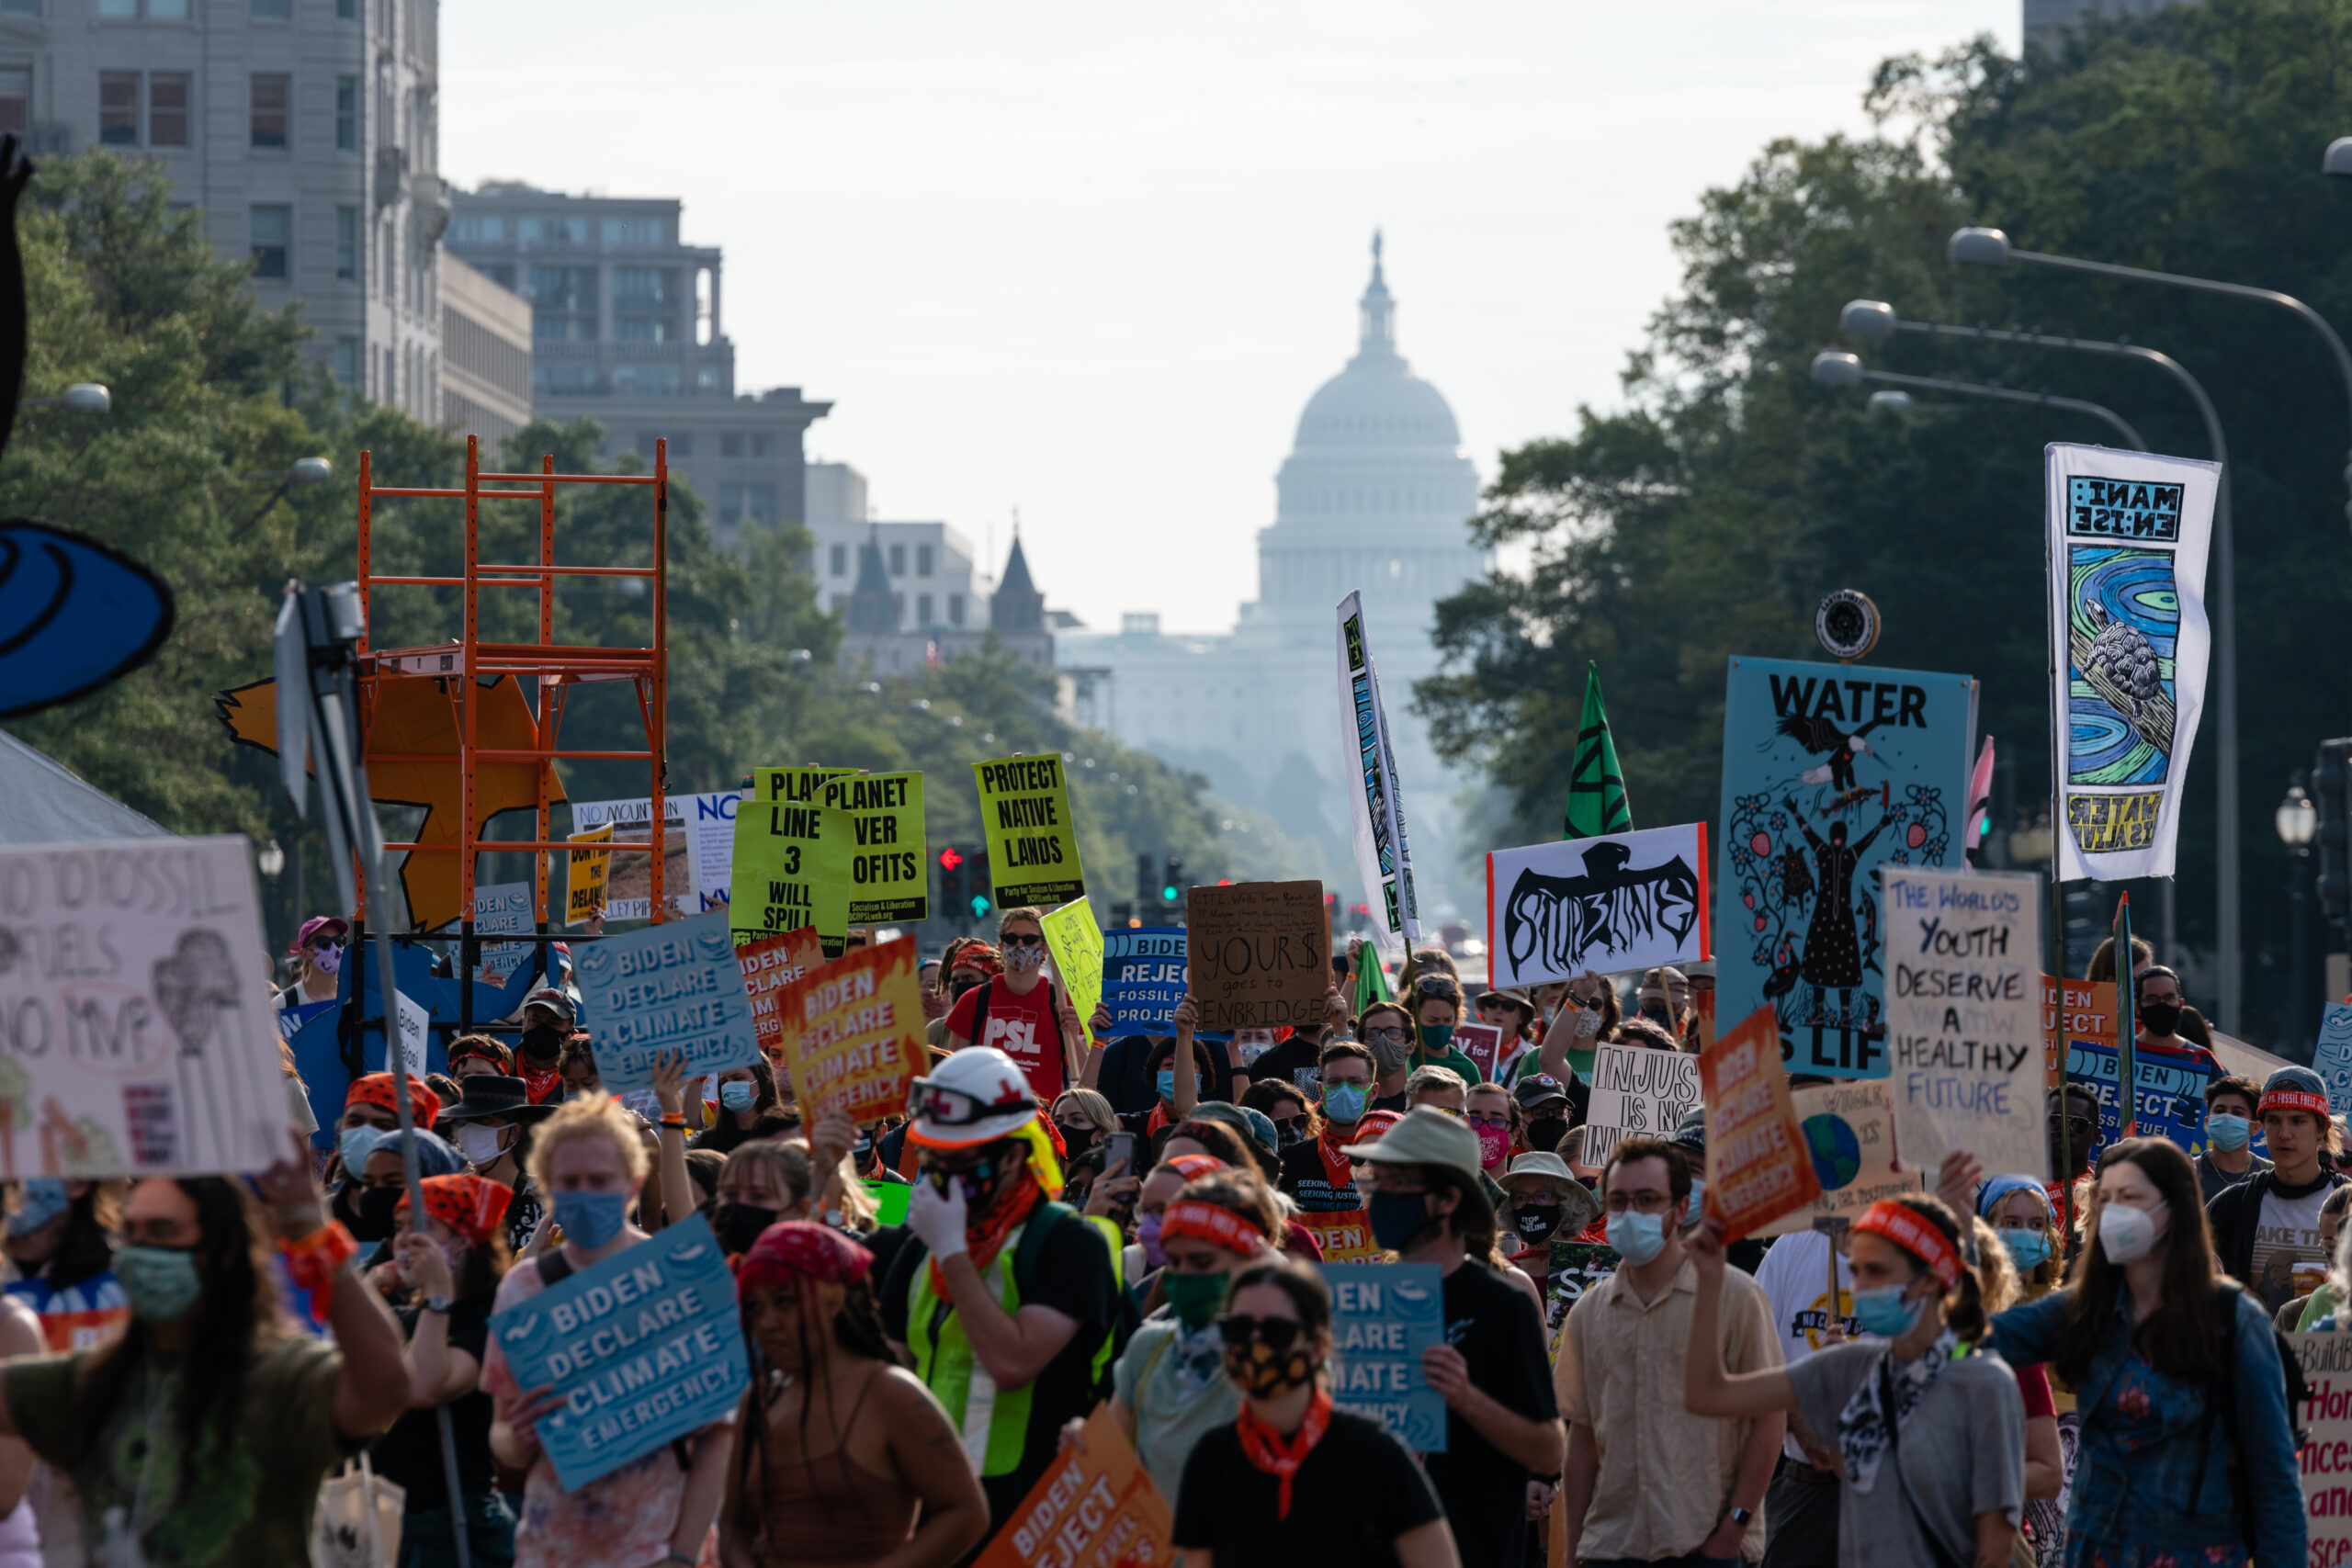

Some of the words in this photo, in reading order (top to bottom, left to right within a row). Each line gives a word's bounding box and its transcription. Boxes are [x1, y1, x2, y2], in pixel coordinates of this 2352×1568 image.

[1769, 674, 1927, 728] WATER
[771, 773, 845, 802] PLAN
[981, 760, 1057, 795] PROTECT
[696, 795, 742, 820] NO
[825, 778, 909, 810] PLANET
[580, 806, 602, 824] NO
[606, 801, 679, 821] MOUNIN
[770, 807, 821, 840] LINE
[997, 796, 1057, 829] NATIVE
[854, 815, 898, 846] VER
[785, 845, 802, 875] 3
[1004, 835, 1063, 868] LANDS
[591, 864, 602, 880] THE
[853, 852, 917, 884] OFITS
[474, 897, 505, 914] IDEN
[769, 881, 812, 908] WILL
[852, 901, 880, 912] Socialism
[880, 900, 886, 909] &
[886, 898, 916, 909] Liberation
[1004, 887, 1020, 897] Party
[1890, 879, 1929, 909] THE
[474, 916, 517, 933] CLARE
[1918, 917, 2010, 958] YOUTH
[616, 938, 695, 976] BIDEN
[739, 946, 789, 976] IDEN
[1136, 939, 1186, 956] BIDE
[1300, 932, 1319, 974] $
[607, 967, 718, 1011] DECLARE
[743, 965, 806, 996] CLARE
[1121, 964, 1188, 984] REJE
[1223, 978, 1257, 999] goes
[1268, 976, 1283, 989] to
[1895, 963, 2025, 1003] DESERVE
[803, 965, 876, 1021] BIDEN
[1118, 989, 1170, 1002] FOSSIL
[2043, 988, 2092, 1009] IDEN
[399, 1008, 420, 1040] Biden
[615, 998, 727, 1044] CLIMATE
[1117, 1009, 1175, 1022] PROJE
[1204, 998, 1325, 1026] ENBRIDGE
[1943, 1006, 1962, 1035] A
[2044, 1012, 2106, 1033] JECT
[798, 1000, 895, 1063] DECLARE
[984, 1018, 1042, 1055] PSL
[401, 1046, 419, 1069] elosi
[1472, 1044, 1490, 1057] for
[1811, 1027, 1886, 1071] LIF
[1896, 1033, 2030, 1073] HEALTHY
[803, 1035, 900, 1095] CLIMATE
[1595, 1046, 1700, 1104] INJUS
[1906, 1073, 2012, 1115] FUTURE
[2277, 1093, 2299, 1104] FOSSIL
[2300, 1094, 2316, 1107] FUELS
[1621, 1095, 1648, 1131] IS
[1298, 1190, 1334, 1201] SEEKING
[2049, 1189, 2063, 1200] SSIL
[1312, 1226, 1364, 1249] DEN
[2256, 1225, 2297, 1244] AKE
[551, 1260, 664, 1336] BIDEN
[1556, 1267, 1617, 1300] ST
[546, 1287, 704, 1382] DECLARE
[1802, 1312, 1816, 1327] NO
[566, 1323, 721, 1418] CLIMATE
[582, 1359, 732, 1452] EMERGENCY
[1012, 1460, 1085, 1560] BIDEN
